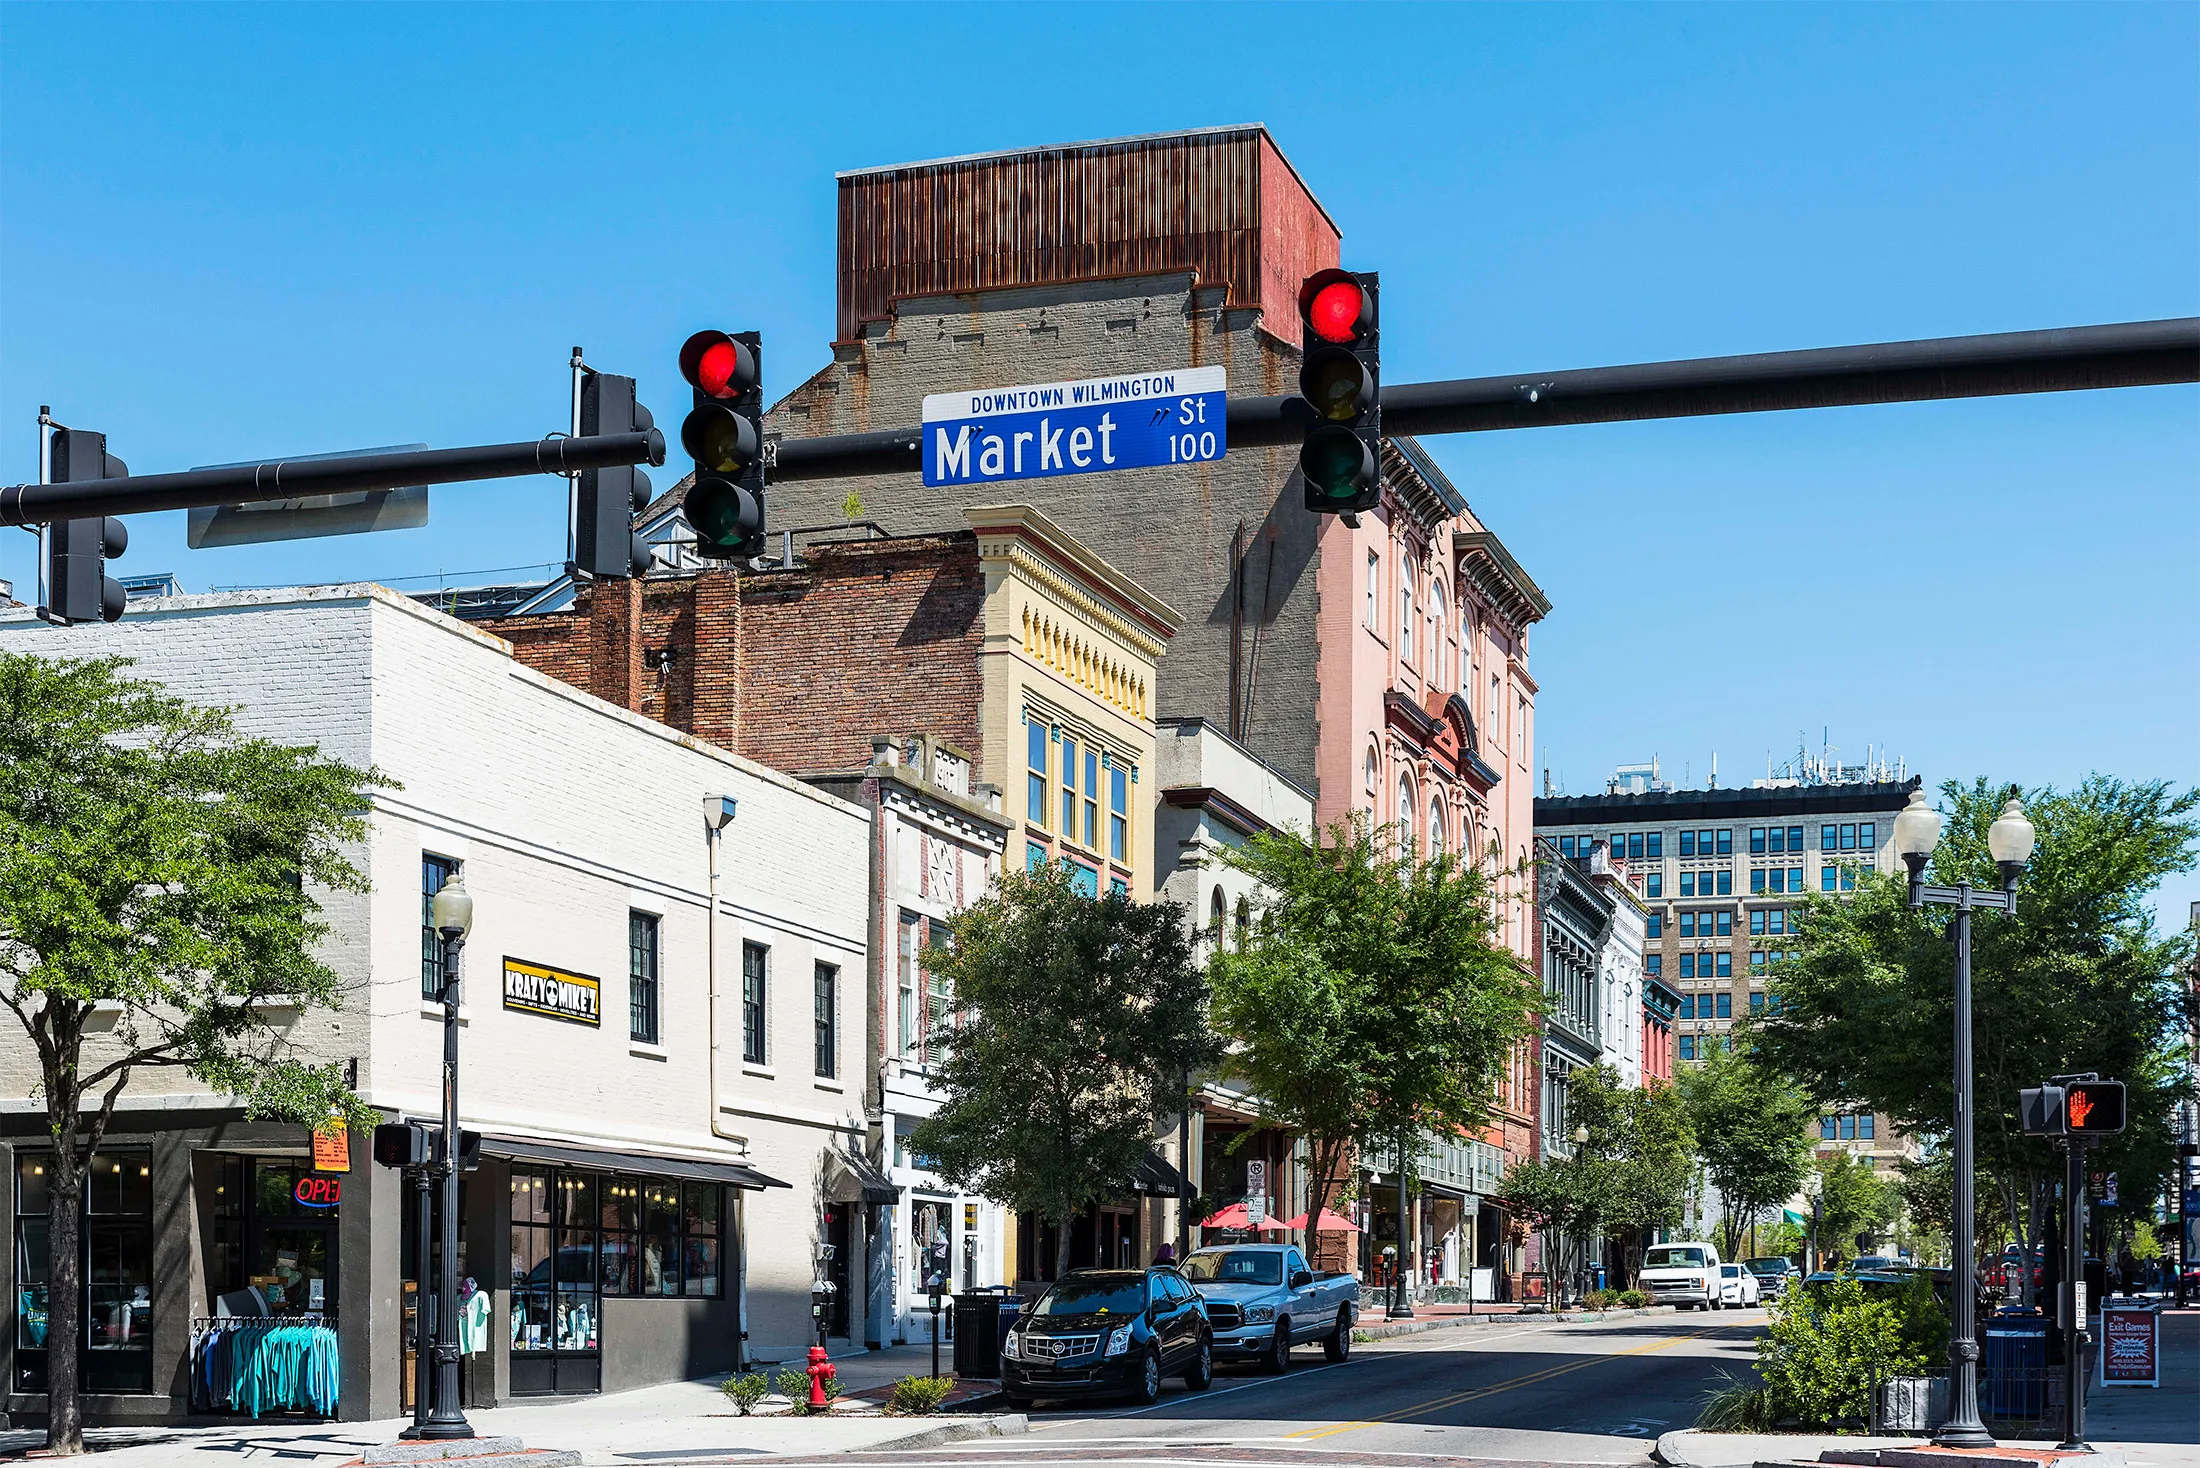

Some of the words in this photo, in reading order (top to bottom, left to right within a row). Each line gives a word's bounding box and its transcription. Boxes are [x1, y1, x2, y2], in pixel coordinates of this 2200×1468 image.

[971, 388, 1064, 414] DOWNTOWN
[1072, 375, 1175, 404] WILMINGTON
[936, 412, 1116, 480] Market
[1179, 396, 1206, 426] St
[1169, 431, 1216, 463] 100
[505, 971, 546, 1002] KRAZY
[558, 980, 597, 1014] MIKE'Z
[1249, 1198, 1255, 1212] 2
[2109, 1322, 2124, 1331] Exit
[2125, 1322, 2151, 1331] Games
